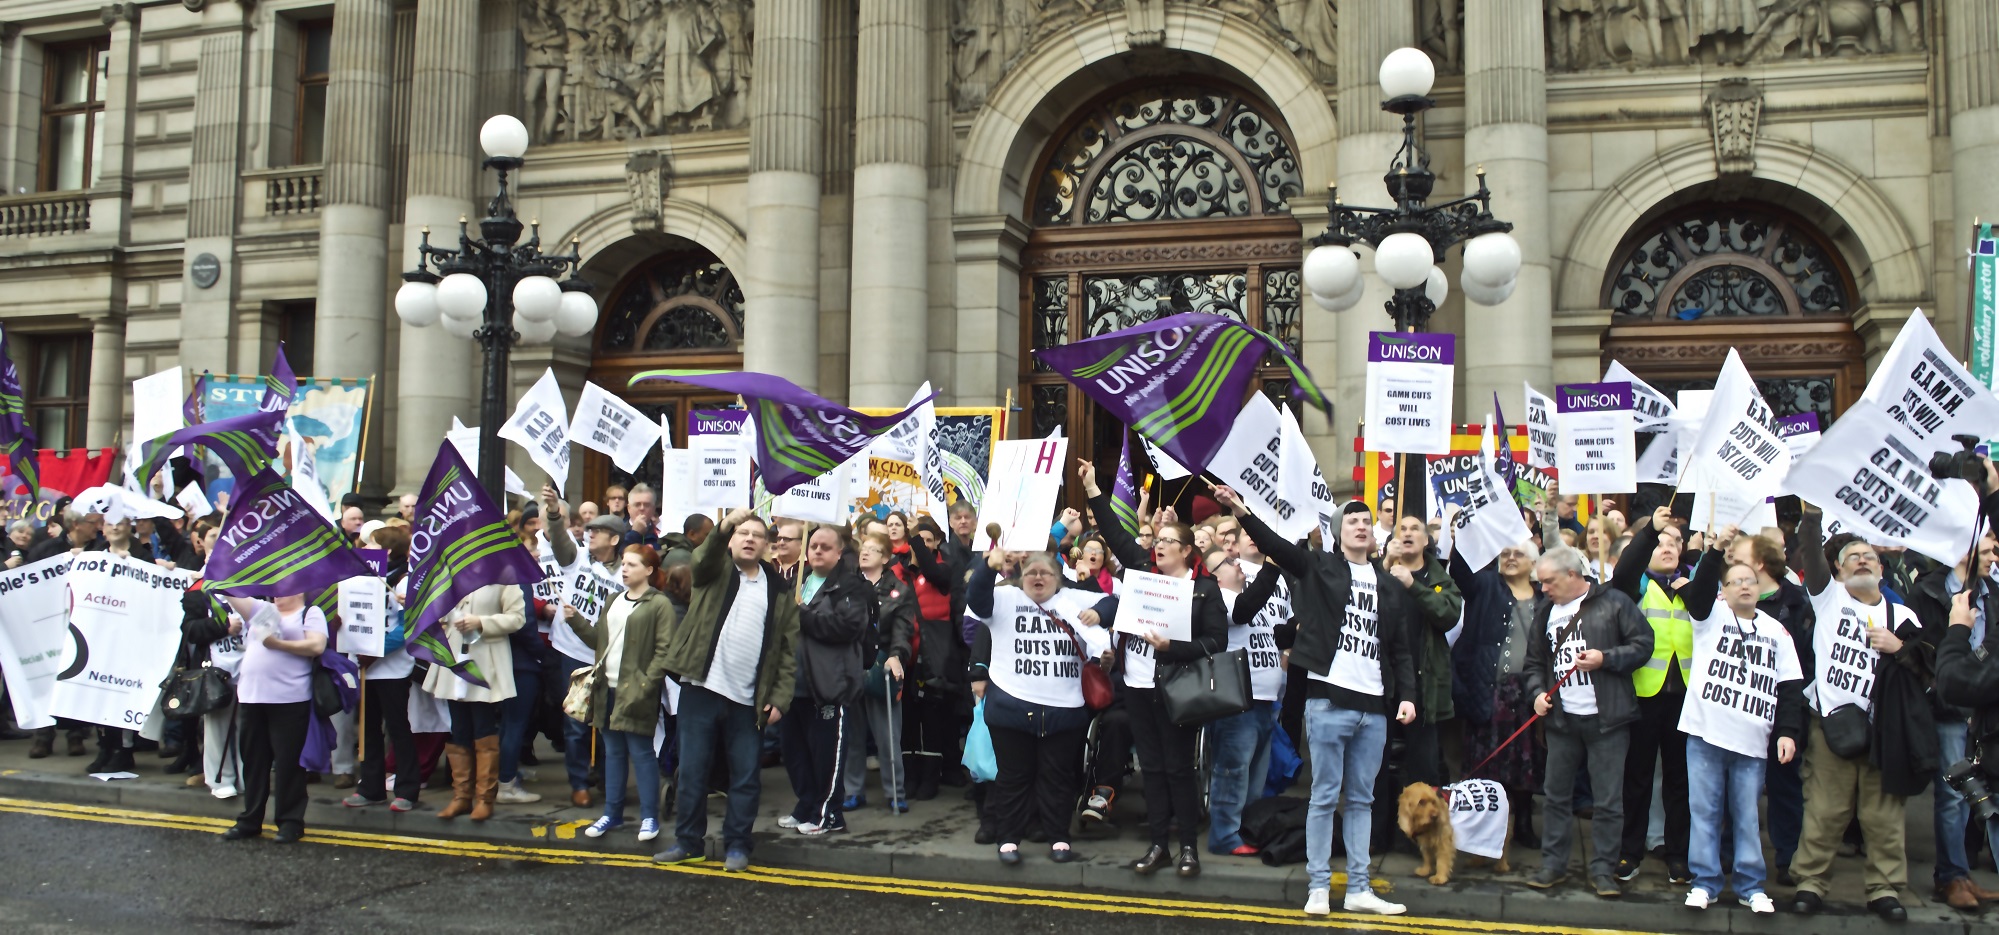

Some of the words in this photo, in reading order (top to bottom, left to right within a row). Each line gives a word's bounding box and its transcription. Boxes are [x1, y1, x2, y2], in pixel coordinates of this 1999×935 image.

[1981, 261, 1992, 302] sector
[1381, 344, 1441, 360] UNISON
[1387, 390, 1410, 398] GAMH
[1411, 391, 1431, 400] CUTS
[1911, 361, 1964, 418] G.A.M.H.
[1399, 404, 1418, 412] WILL
[1567, 393, 1621, 408] UNISON
[698, 420, 741, 433] UNISON
[1385, 417, 1406, 426] COST
[1408, 418, 1431, 427] LIVES
[1912, 403, 1944, 434] WILL
[1575, 438, 1594, 446] GAMH
[1729, 421, 1761, 449] CUTS
[1753, 440, 1780, 465] WILL
[704, 457, 720, 465] GAMH
[721, 457, 737, 465] CUTS
[1586, 450, 1603, 458] WILL
[1253, 453, 1279, 483] CUTS
[1575, 463, 1594, 471] COST
[1730, 455, 1762, 481] LIVES
[804, 478, 820, 486] ILL
[1870, 448, 1940, 508] G.A.M.H.
[791, 488, 809, 498] COST
[811, 491, 831, 501] LIVES
[1240, 467, 1271, 496] COST
[1265, 487, 1296, 521] LIVES
[1311, 481, 1331, 502] COS
[1853, 467, 1895, 503] CUTS
[1890, 494, 1929, 527] WILL
[1835, 485, 1876, 516] COST
[1869, 509, 1911, 538] LIVES
[76, 559, 108, 573] not
[111, 563, 149, 585] private
[151, 573, 190, 590] greed
[536, 580, 564, 597] CUTS
[1144, 590, 1162, 598] SERVICE
[84, 592, 126, 608] Action
[571, 593, 597, 616] CUTS
[360, 625, 373, 634] LIVES
[1155, 621, 1169, 629] CUTS
[1015, 638, 1051, 656] CUTS
[1249, 633, 1274, 650] CUTS
[1337, 632, 1360, 654] OST
[1252, 651, 1279, 668] COST
[1831, 643, 1868, 670] CUTS
[1015, 659, 1050, 677] COST
[1053, 661, 1079, 678] LIVES
[1708, 658, 1747, 685] CUTS
[88, 670, 143, 690] Network
[1827, 665, 1862, 693] COST
[1702, 681, 1742, 709] COST
[1742, 694, 1776, 723] LIVES
